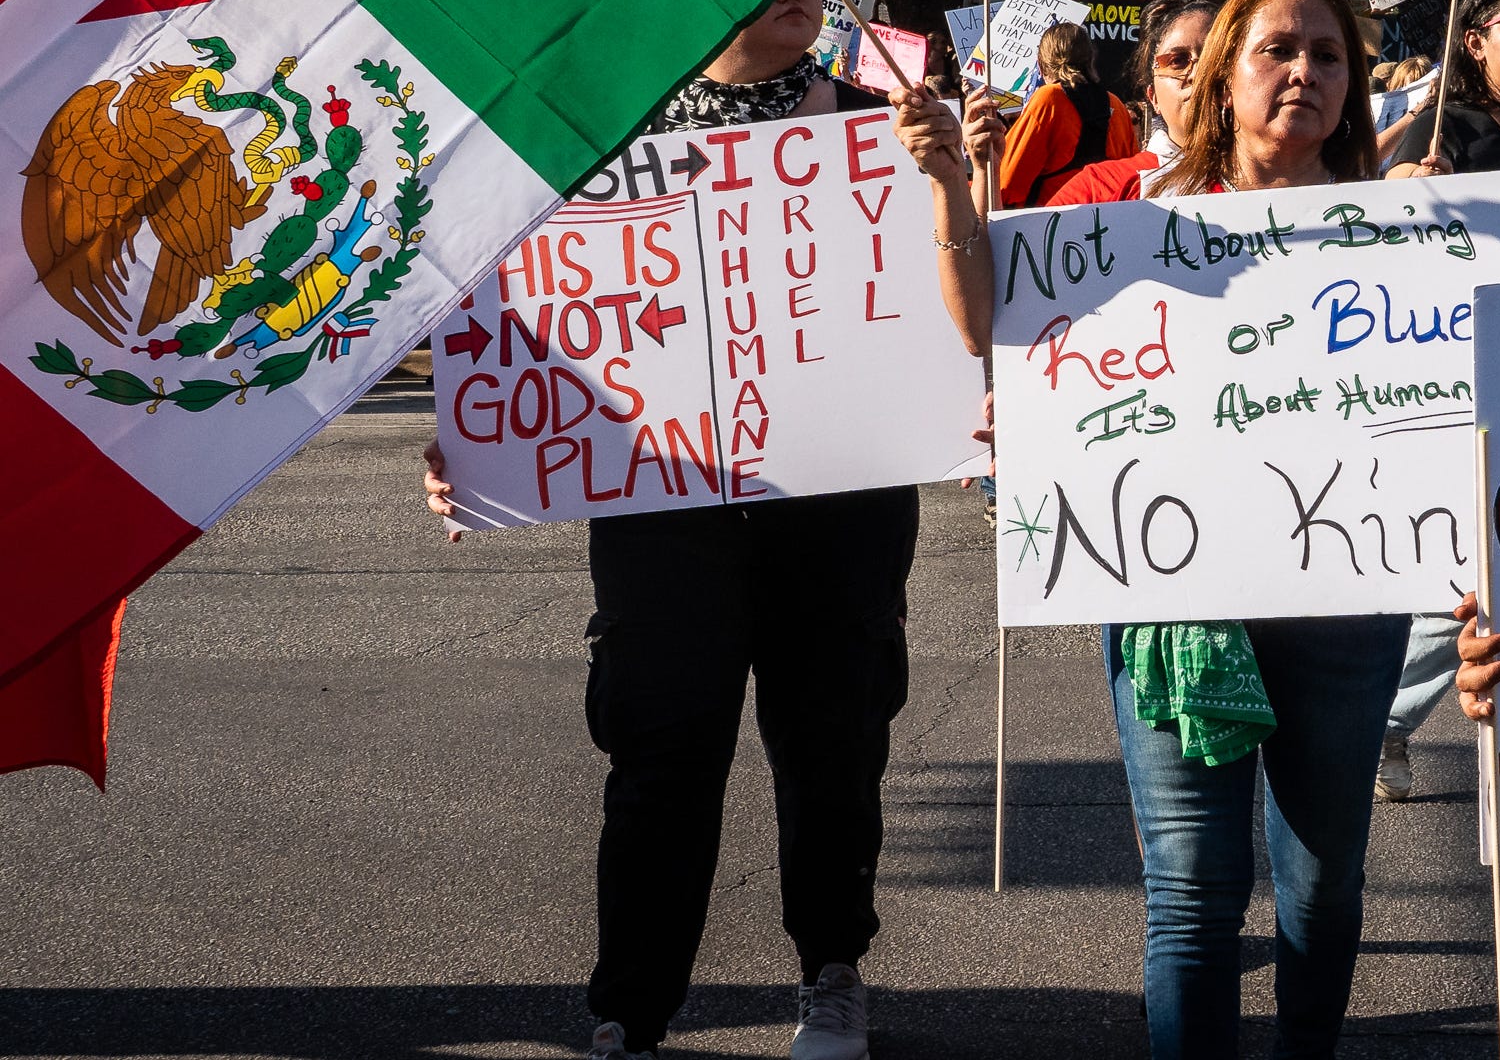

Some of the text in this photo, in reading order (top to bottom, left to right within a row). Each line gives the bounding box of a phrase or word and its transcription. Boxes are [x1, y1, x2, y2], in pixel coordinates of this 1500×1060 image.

[997, 23, 1030, 41] THAT
[1002, 39, 1033, 58] FEED
[1086, 3, 1140, 25] MOVE
[459, 221, 682, 311] HIS IS
[1004, 202, 1478, 306] Not About Being
[500, 292, 643, 368] NOT
[1026, 278, 1472, 391] Red or Blue
[453, 356, 646, 445] GODS
[1075, 388, 1178, 451] It's
[1213, 376, 1323, 430] About
[536, 410, 723, 511] PLAN
[1263, 458, 1468, 596] Kin
